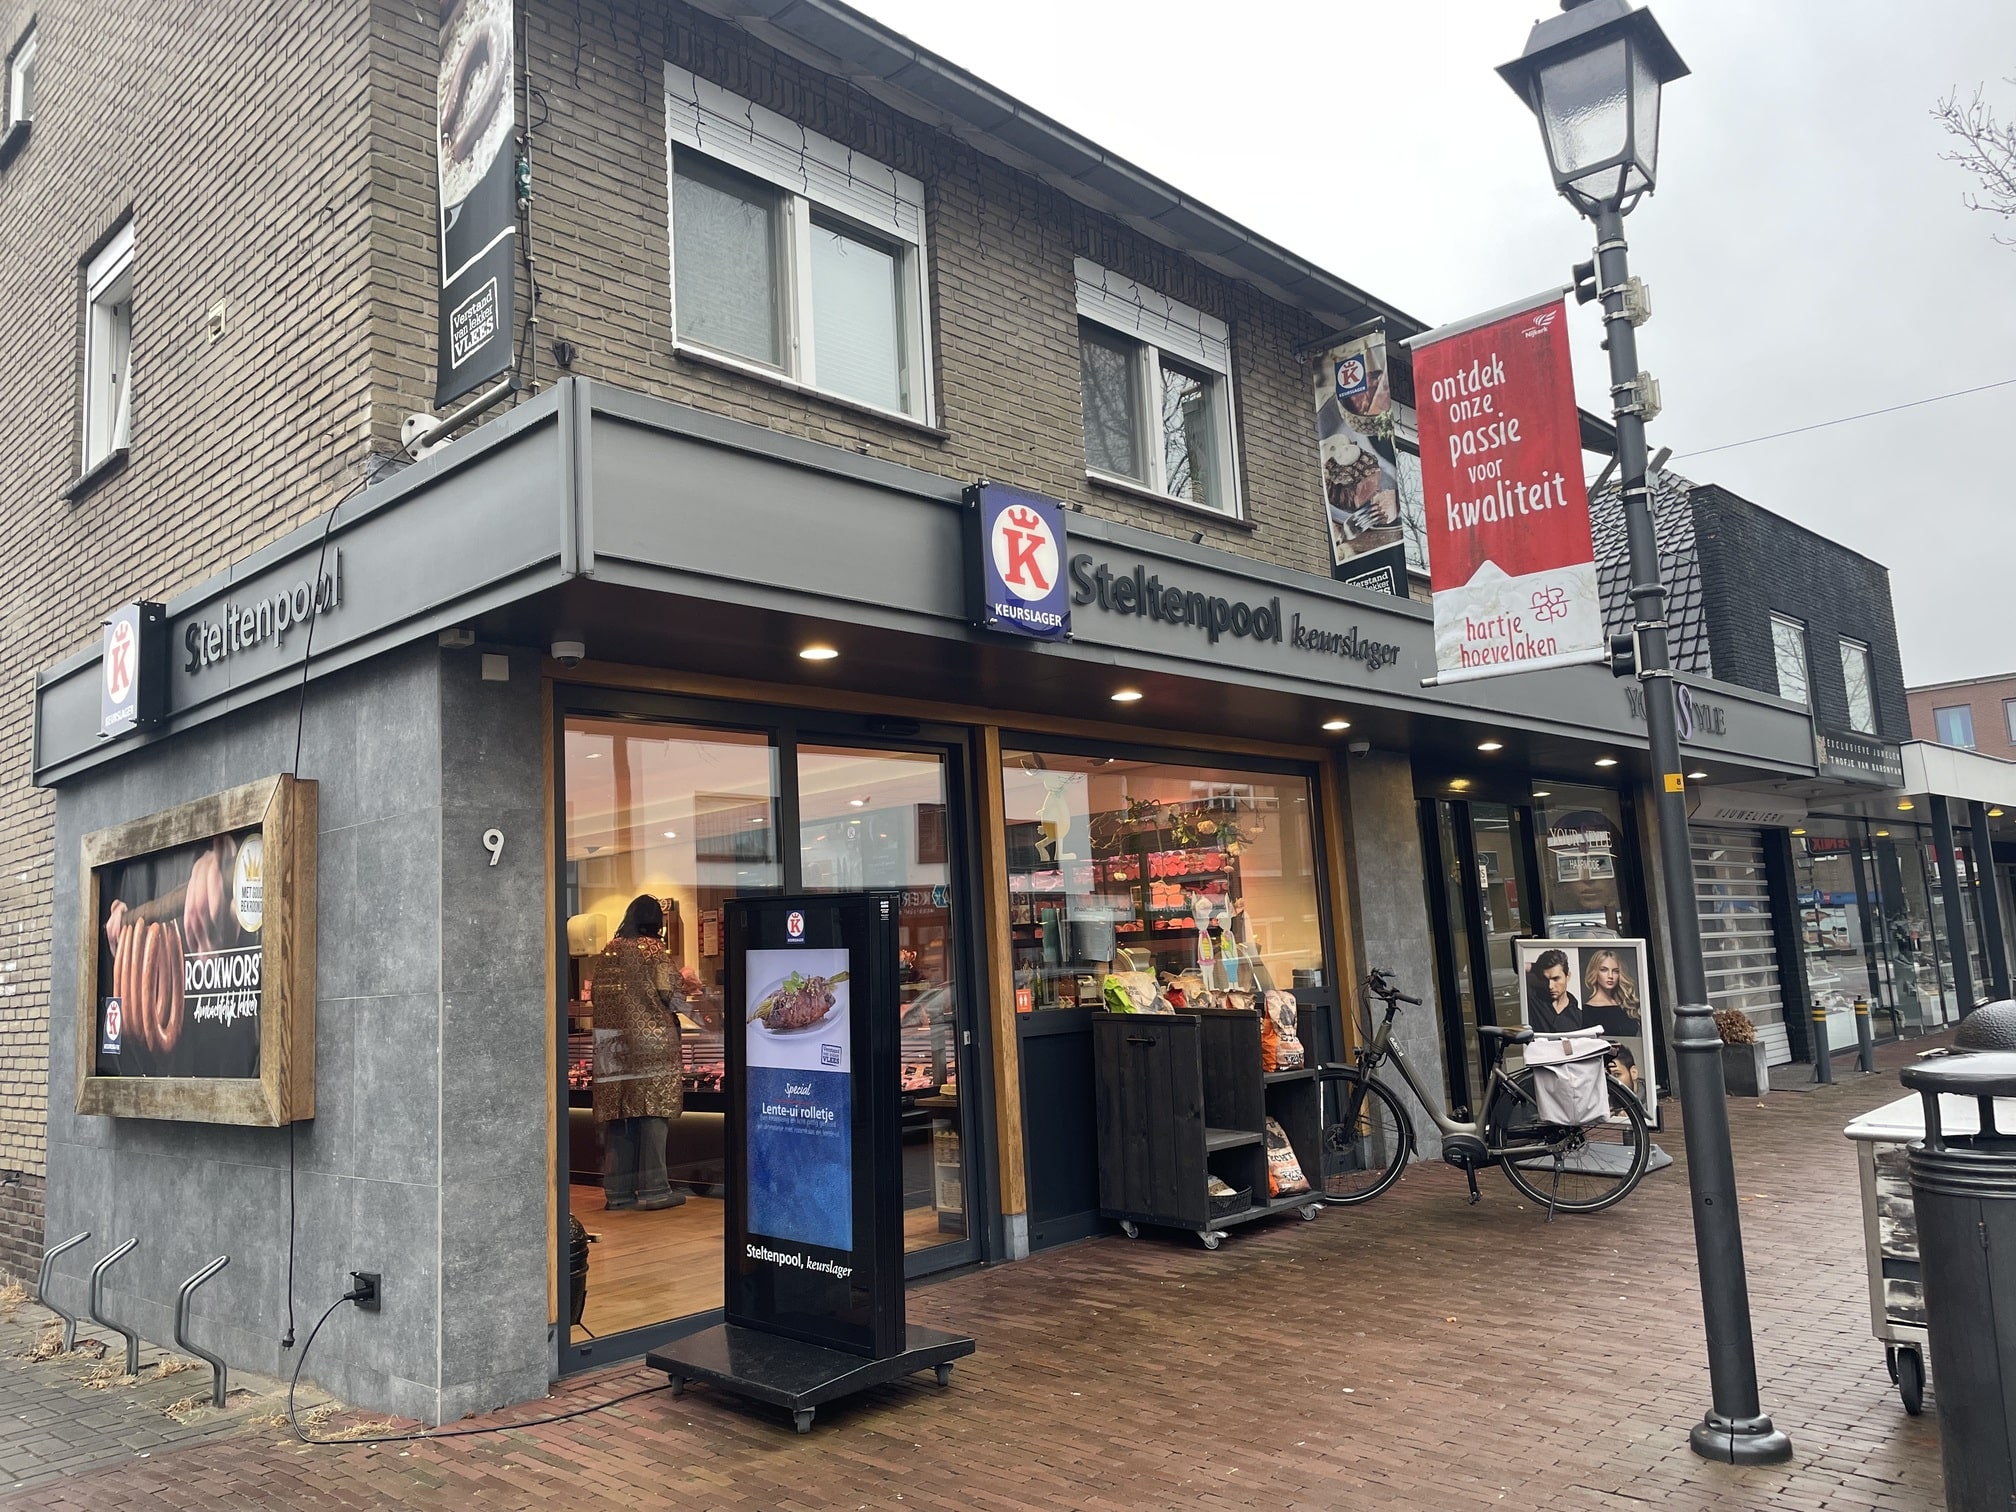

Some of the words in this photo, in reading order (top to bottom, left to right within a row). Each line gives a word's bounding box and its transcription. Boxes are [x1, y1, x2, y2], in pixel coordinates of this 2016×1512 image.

[453, 289, 492, 328] Verstand
[454, 327, 468, 342] van
[469, 304, 493, 331] lekker
[455, 315, 494, 357] VLEES
[1341, 366, 1360, 386] K
[1431, 353, 1506, 402] ontdek
[1449, 394, 1494, 423] onze
[1449, 412, 1521, 468] passie
[1468, 459, 1503, 483] voor
[1446, 471, 1568, 531] kwaliteit
[1002, 527, 1049, 590] K
[185, 547, 340, 674] Steltenpool
[995, 602, 1063, 628] KEURSLAGER
[1072, 553, 1283, 643] Steltenpool
[1292, 612, 1401, 670] keurslager
[1466, 611, 1523, 642] hartje
[110, 640, 131, 695] K
[1460, 633, 1557, 668] hoevelaken
[1677, 684, 1727, 740] SYLE
[1857, 761, 1869, 770] VAN
[483, 828, 505, 866] 9
[242, 886, 252, 899] MET
[790, 919, 801, 933] K
[108, 1012, 118, 1035] K
[784, 1083, 812, 1098] Special
[762, 1102, 798, 1117] Lente-ui
[800, 1106, 834, 1123] rolletje
[746, 1243, 804, 1270] Steltenpool,
[806, 1256, 852, 1279] keurslager
